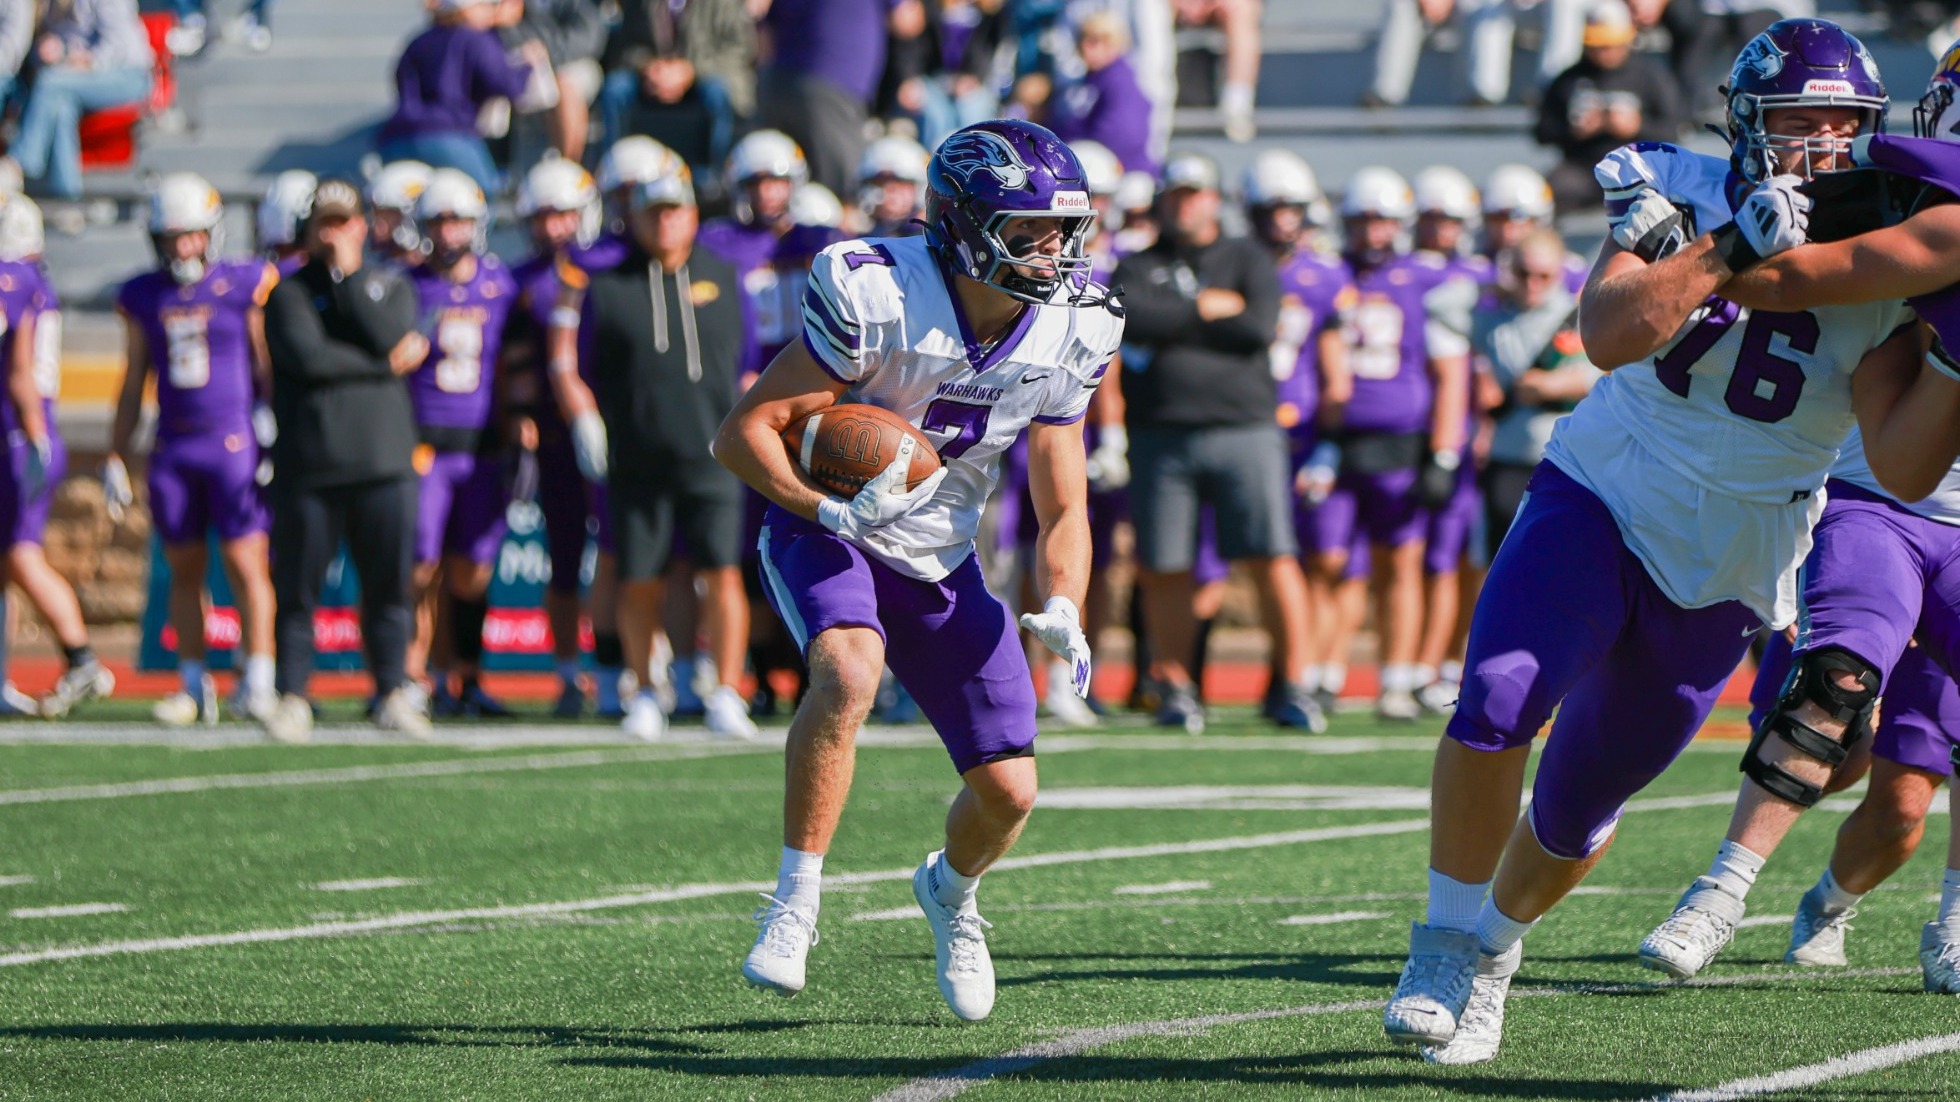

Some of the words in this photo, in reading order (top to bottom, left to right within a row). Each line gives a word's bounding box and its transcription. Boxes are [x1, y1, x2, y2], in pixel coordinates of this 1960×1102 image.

[1057, 197, 1088, 207] Riddell
[842, 243, 897, 271] 7
[1653, 294, 1820, 423] 76
[936, 382, 1004, 401] WARHAWKS
[921, 398, 993, 466] 7
